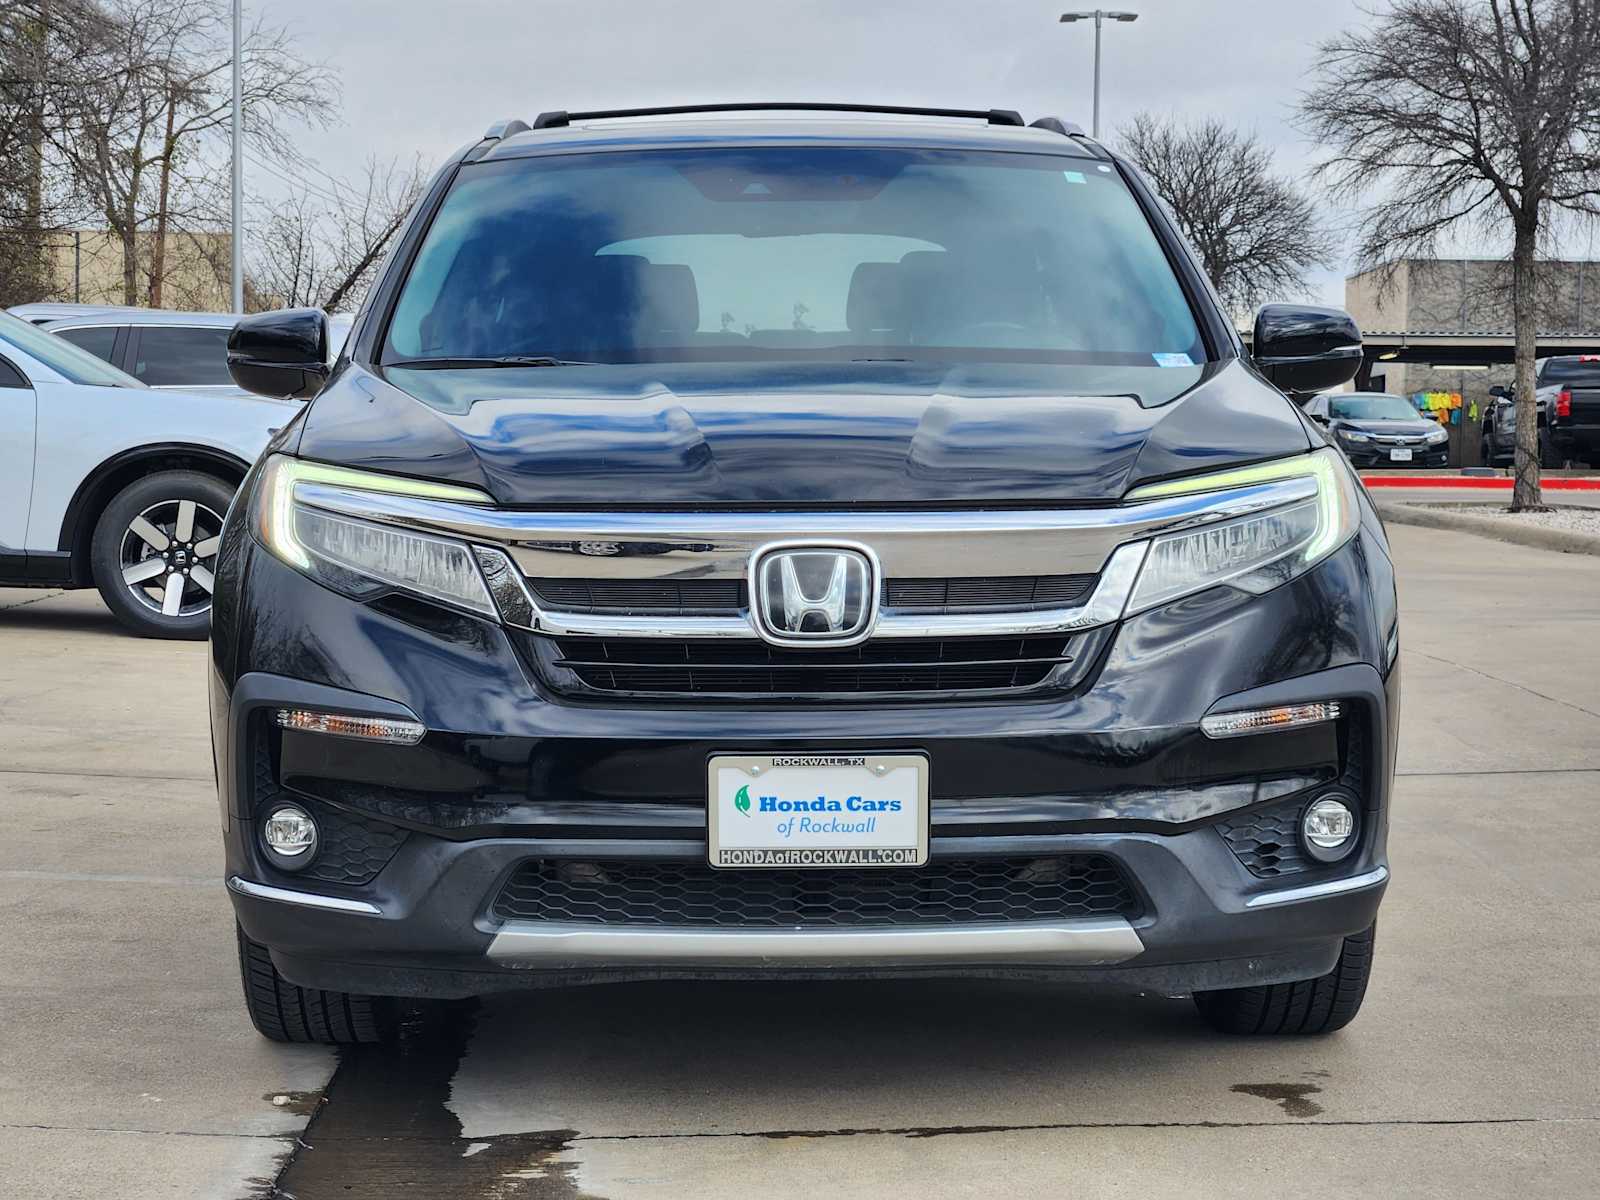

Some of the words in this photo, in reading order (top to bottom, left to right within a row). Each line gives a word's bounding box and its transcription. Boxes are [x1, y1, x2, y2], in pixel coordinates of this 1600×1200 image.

[848, 758, 864, 766] TX
[759, 796, 841, 812] Honda
[846, 795, 902, 812] Cars
[777, 817, 795, 838] of
[800, 816, 876, 834] Rockwall
[720, 849, 917, 864] HONDAofROCKWALL.COM
